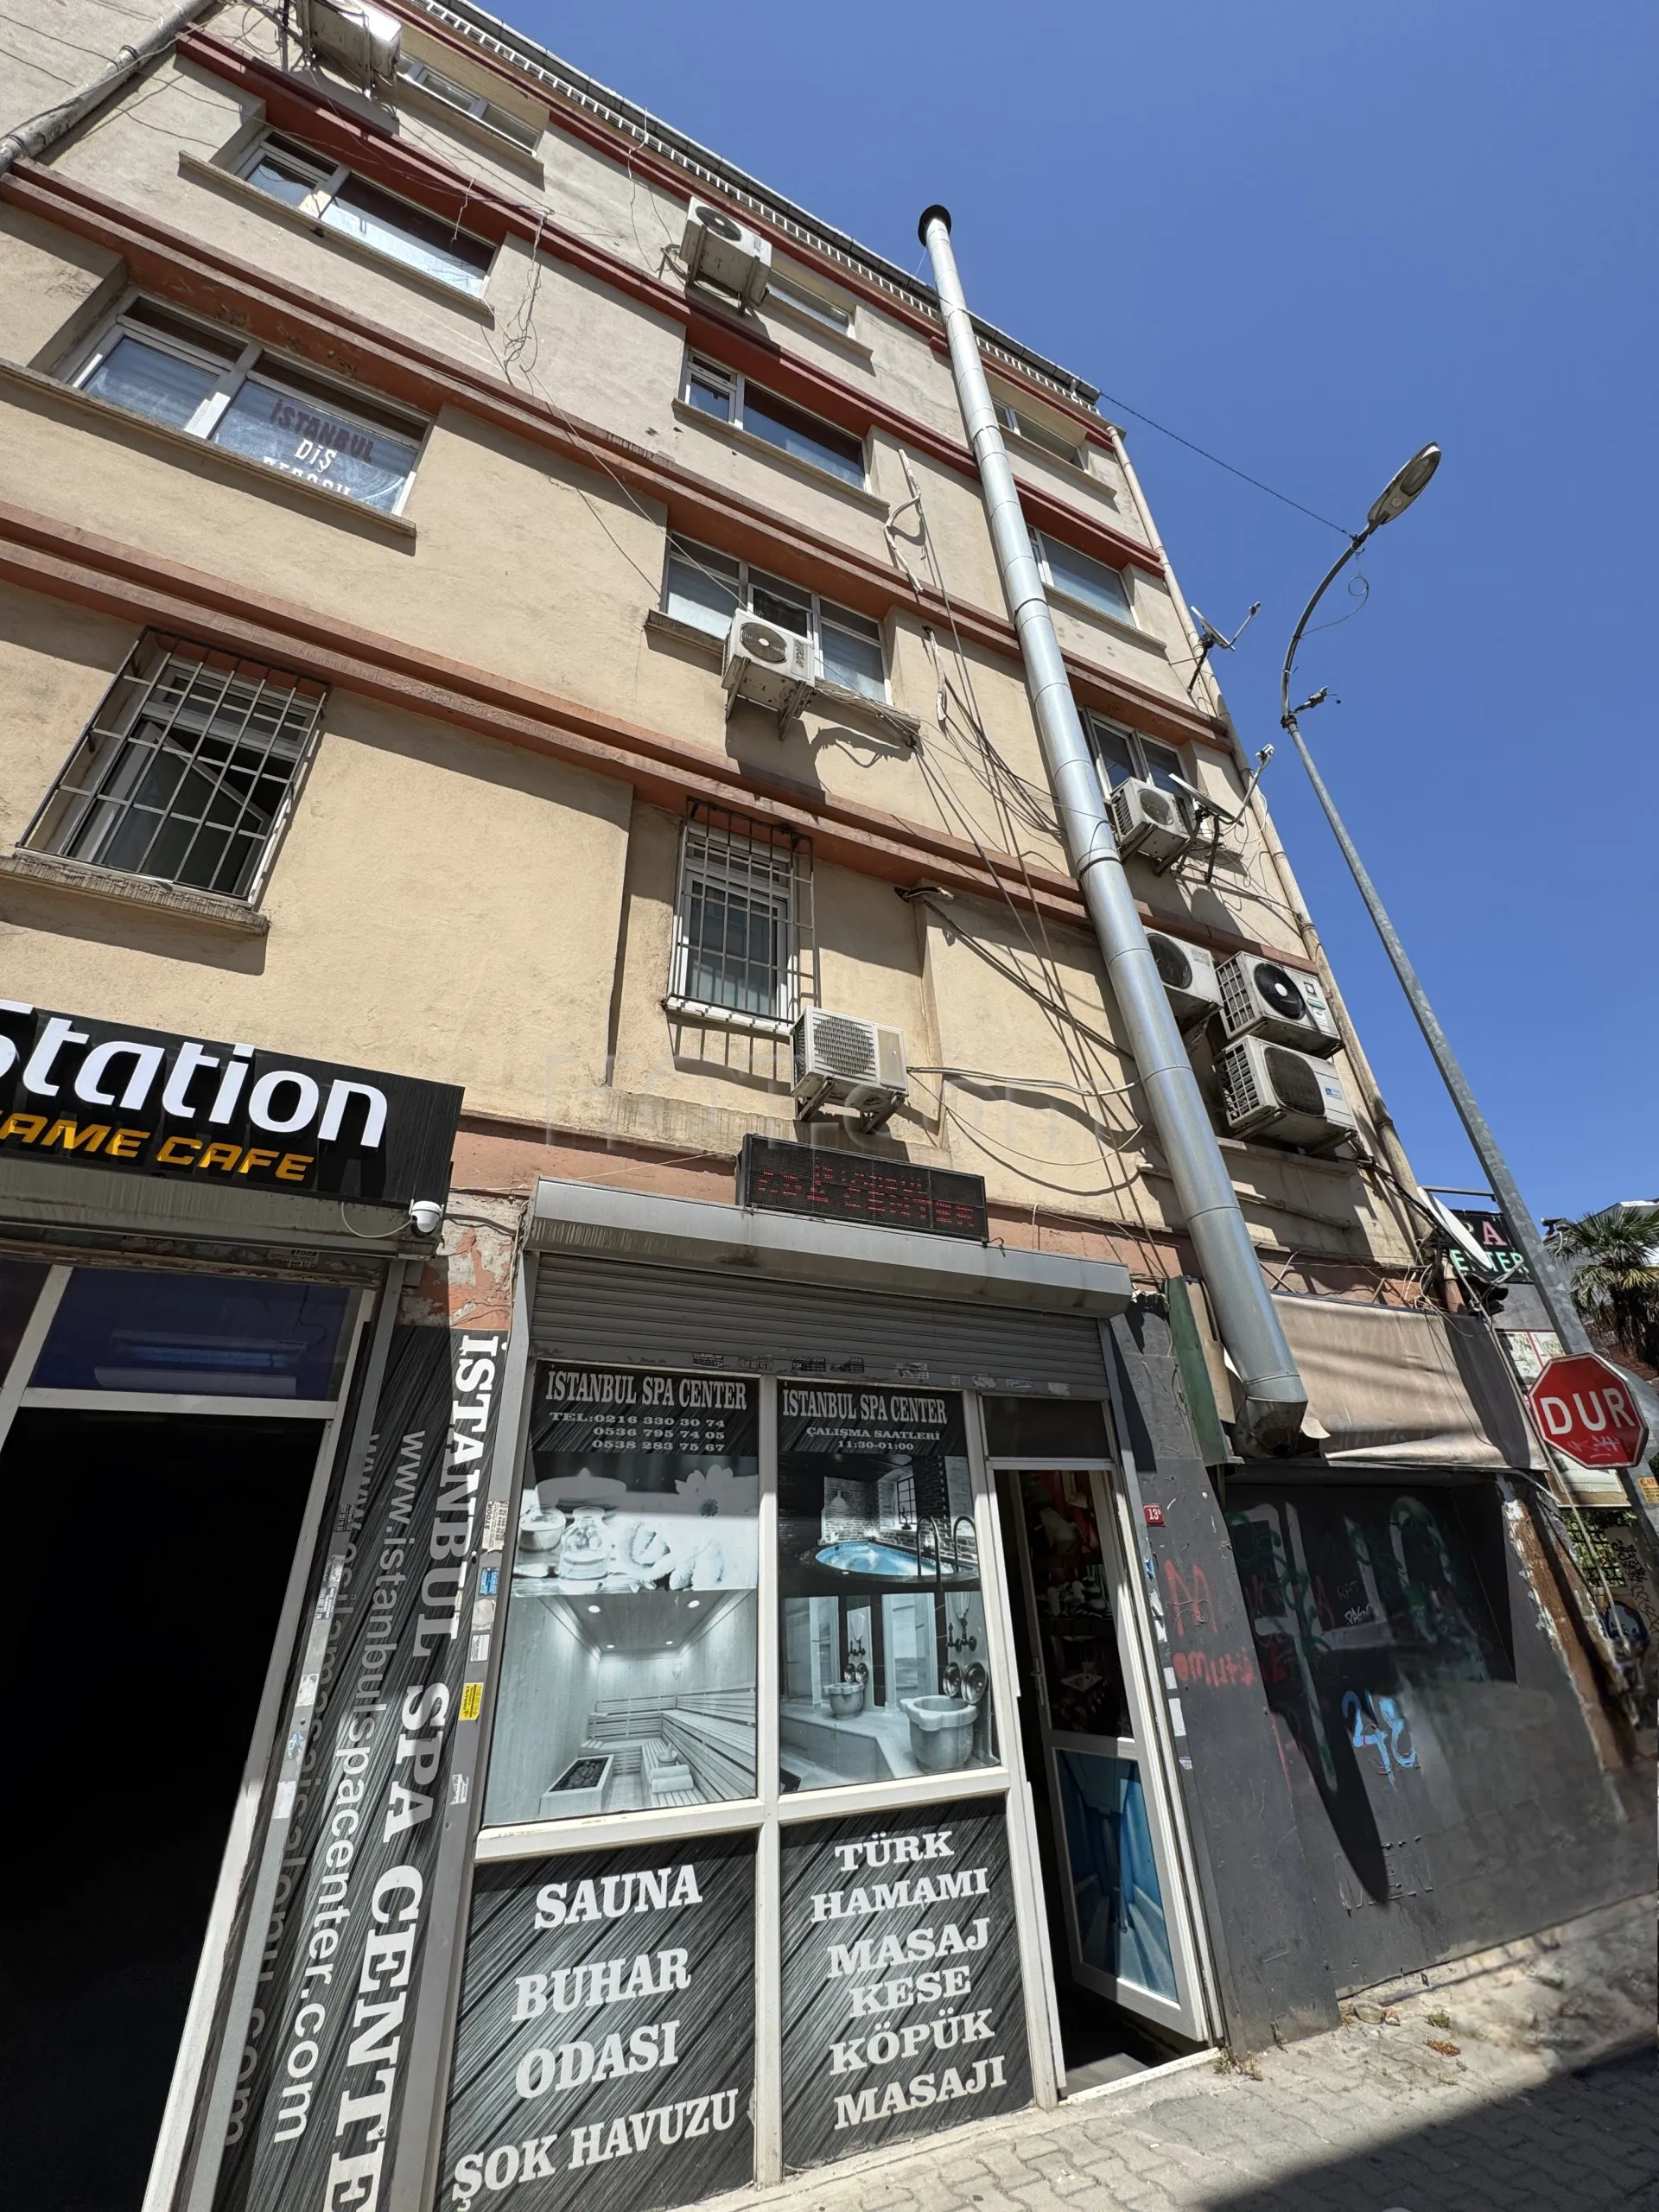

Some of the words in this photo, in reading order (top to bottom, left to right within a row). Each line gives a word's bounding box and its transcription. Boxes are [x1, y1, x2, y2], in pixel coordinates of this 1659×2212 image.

[0, 1109, 151, 1159] AME
[156, 1136, 315, 1182] CAFE
[545, 1363, 637, 1404] İSTANBUL
[641, 1376, 675, 1406] SPA
[679, 1378, 747, 1410] CENTER
[782, 1381, 856, 1420] İSTANBUL
[860, 1393, 888, 1421] SPA
[890, 1395, 948, 1424] CENTER
[1540, 1388, 1637, 1435] DUR
[592, 1440, 637, 1449] 0538
[642, 1441, 674, 1451] 283
[679, 1442, 700, 1452] 75
[705, 1444, 725, 1452] 67
[593, 1427, 637, 1436] 0536
[643, 1428, 674, 1438] 795
[680, 1430, 700, 1439] 74
[705, 1431, 725, 1440] 05
[643, 1416, 675, 1426] 330
[680, 1418, 701, 1427] 30
[705, 1419, 725, 1427] 74
[806, 1427, 870, 1439] ÇALIŞMA
[874, 1430, 941, 1440] SAATLERİ
[838, 1440, 914, 1451] 11:30-01:00
[412, 1333, 509, 1658] İSTANBUL
[274, 1429, 426, 2145] www.istanbulspacenter.com
[384, 1681, 451, 1843] SPA
[835, 1830, 955, 1872] TÜRK
[534, 1863, 702, 1930] SAUNA
[810, 1867, 989, 1923] HAMAMI
[827, 1916, 991, 1980] MASAJ
[511, 1947, 692, 2023] BUHAR
[849, 1966, 971, 2018] KESE
[515, 2019, 680, 2100] ODASI
[830, 2007, 996, 2076] KÖPÜK
[834, 2056, 1007, 2130] MASAJI
[450, 2133, 557, 2212] ŞOK
[567, 2088, 740, 2171] HAVUZU
